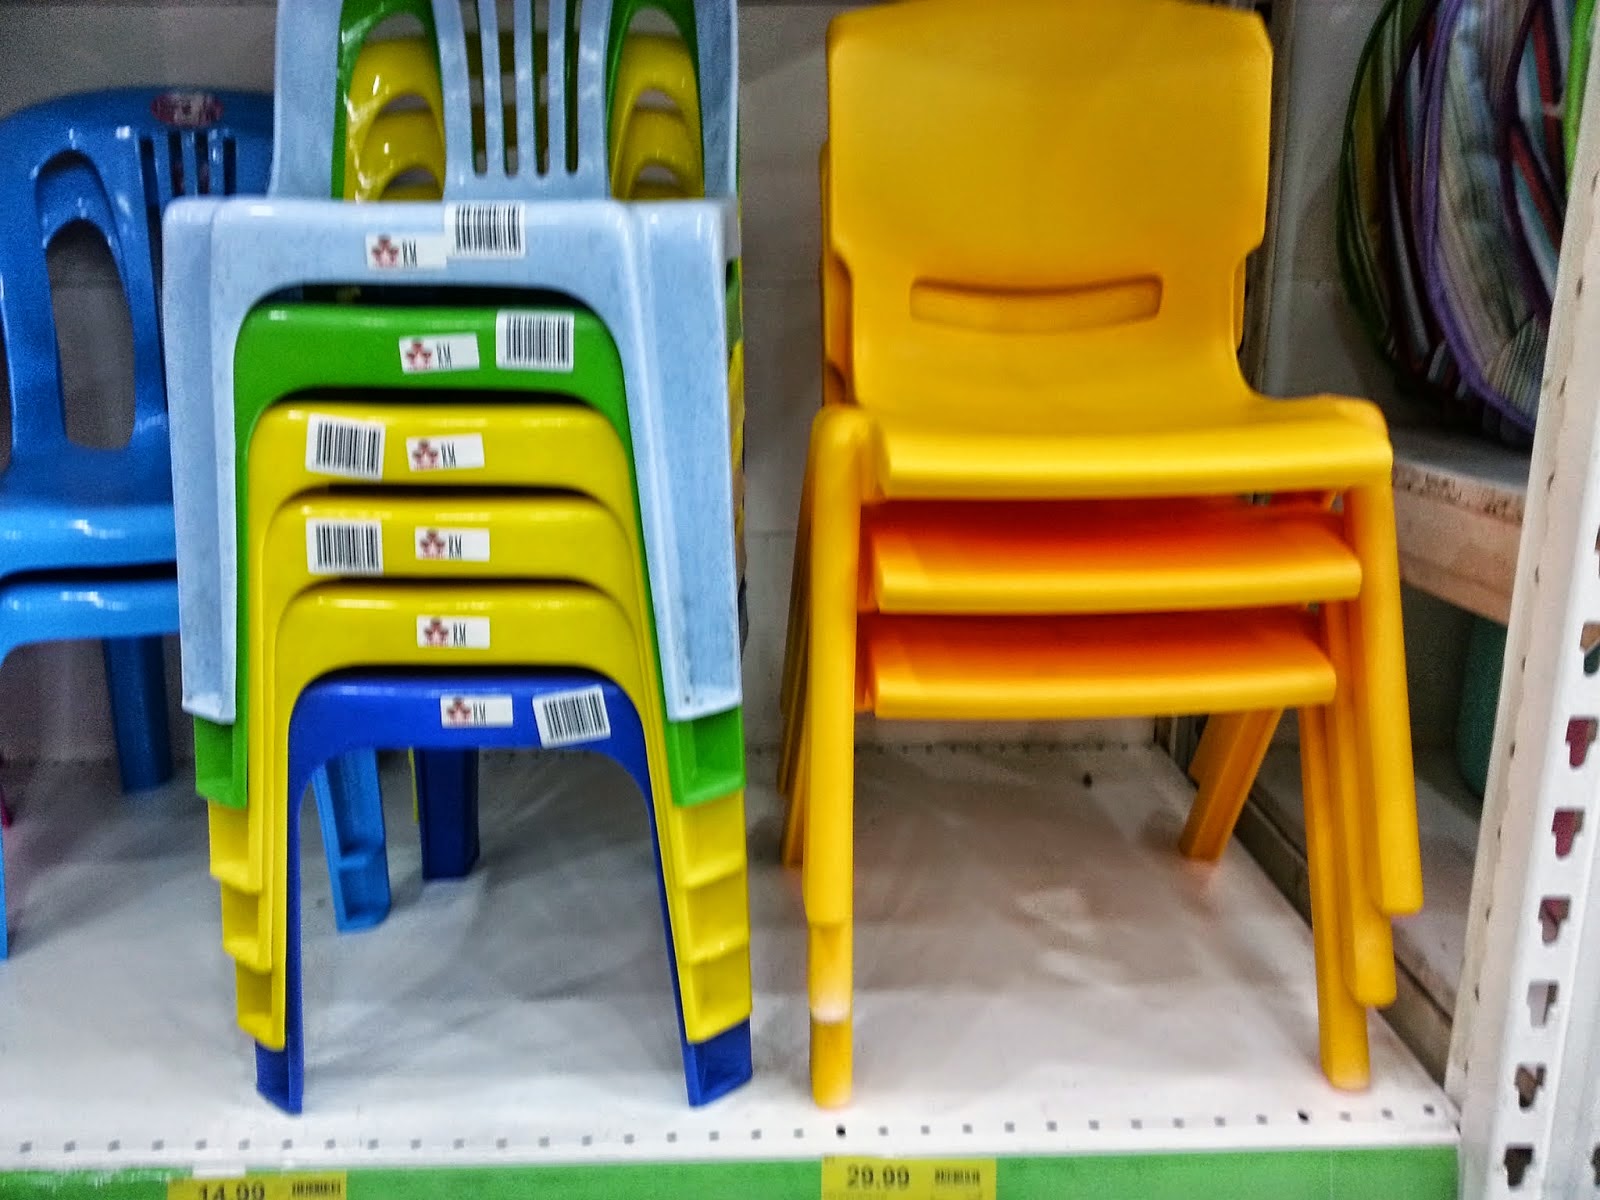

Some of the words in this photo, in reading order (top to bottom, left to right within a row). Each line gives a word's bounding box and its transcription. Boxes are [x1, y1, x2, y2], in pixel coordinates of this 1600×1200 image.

[453, 622, 466, 648] RM
[473, 702, 486, 726] RM
[847, 1163, 910, 1190] 29.99
[198, 1180, 265, 1200] 1499
